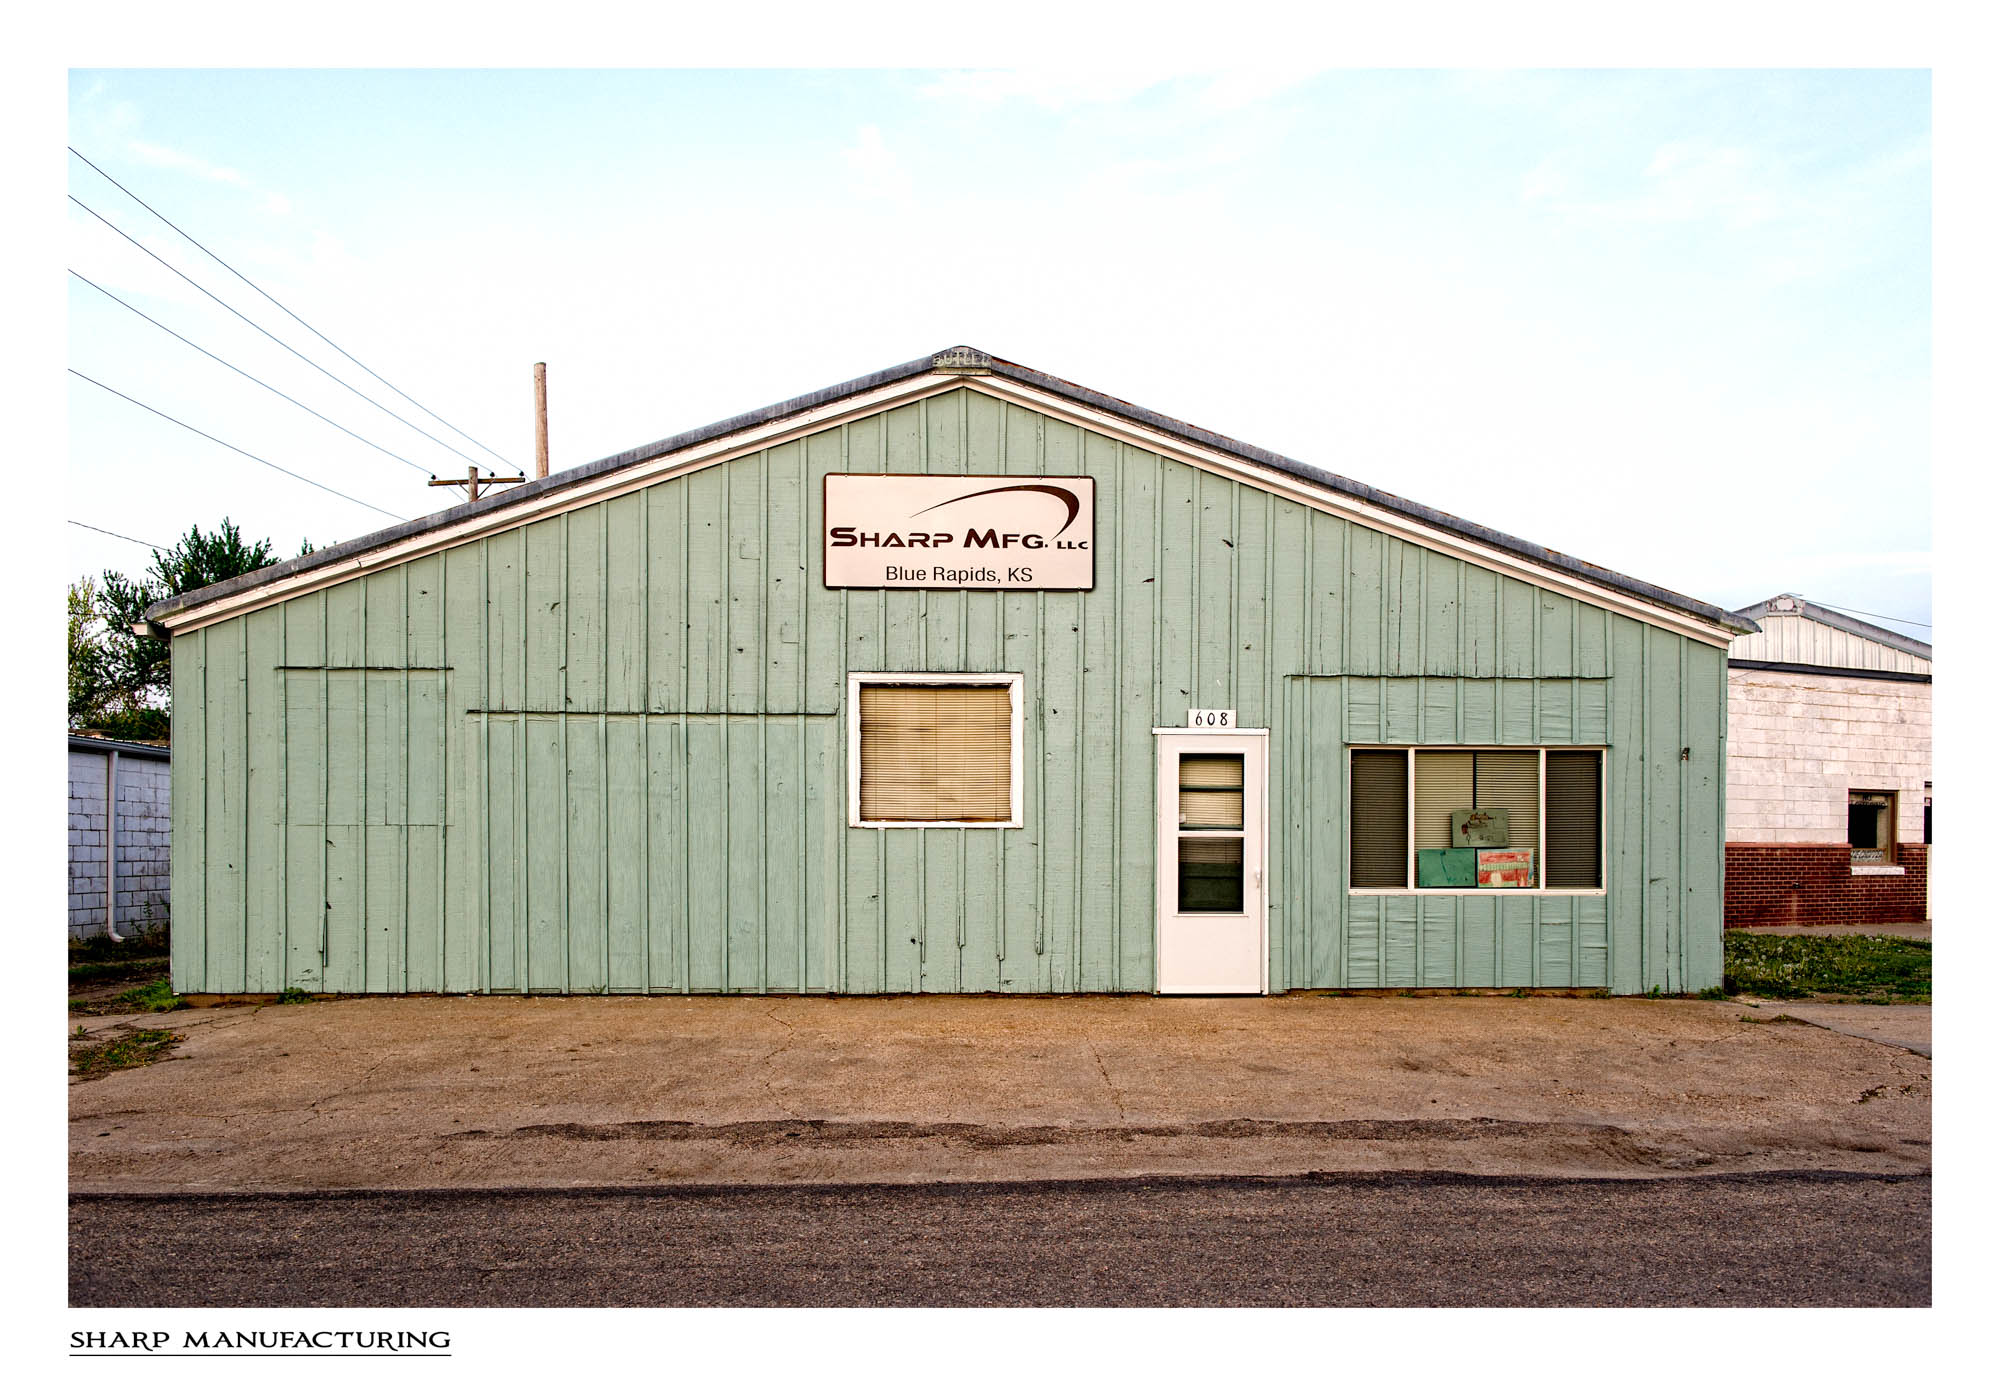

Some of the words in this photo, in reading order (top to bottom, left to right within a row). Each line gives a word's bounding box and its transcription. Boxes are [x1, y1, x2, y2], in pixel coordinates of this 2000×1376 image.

[830, 527, 953, 547] SHARP
[963, 528, 1048, 549] MFG.
[1056, 540, 1089, 550] LLC
[886, 566, 926, 581] Blue
[933, 566, 1001, 584] Rapids,
[1008, 567, 1033, 582] KS
[1195, 710, 1228, 726] 608
